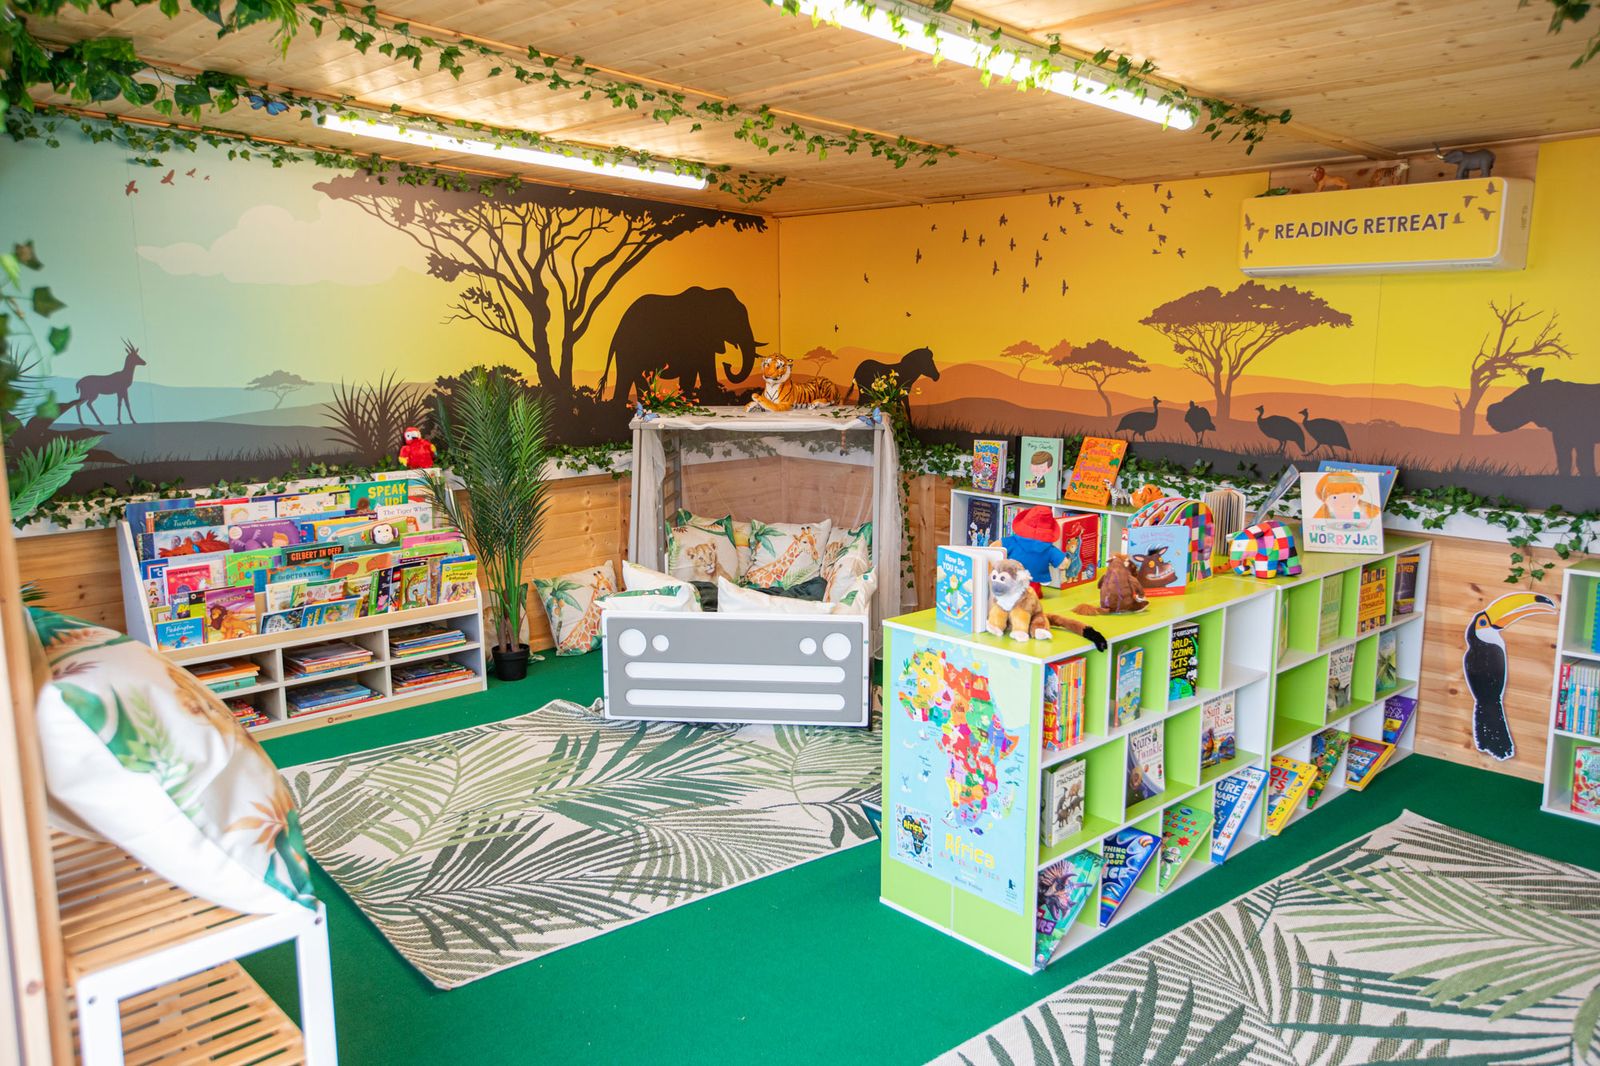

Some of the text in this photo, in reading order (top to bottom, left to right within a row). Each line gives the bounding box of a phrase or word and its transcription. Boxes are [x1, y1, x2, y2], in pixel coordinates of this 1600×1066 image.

[1275, 213, 1448, 239] READING RETREAT
[368, 483, 406, 499] SPEAK
[1309, 532, 1378, 546] WORRY JAR
[291, 546, 342, 561] GILBERT IN DEEP
[945, 553, 965, 567] How Do
[286, 570, 324, 580] OCTONAUTS
[943, 561, 967, 577] YOU Feel?
[1172, 637, 1192, 649] ORLD-
[1171, 657, 1188, 669] ACTS
[1206, 705, 1220, 719] Sun
[1132, 736, 1152, 752] Stars
[1136, 741, 1162, 761] Twinkle
[1056, 768, 1086, 787] DINOSAURS
[904, 819, 923, 833] Africa
[945, 833, 996, 870] Africa
[1104, 846, 1127, 854] THING
